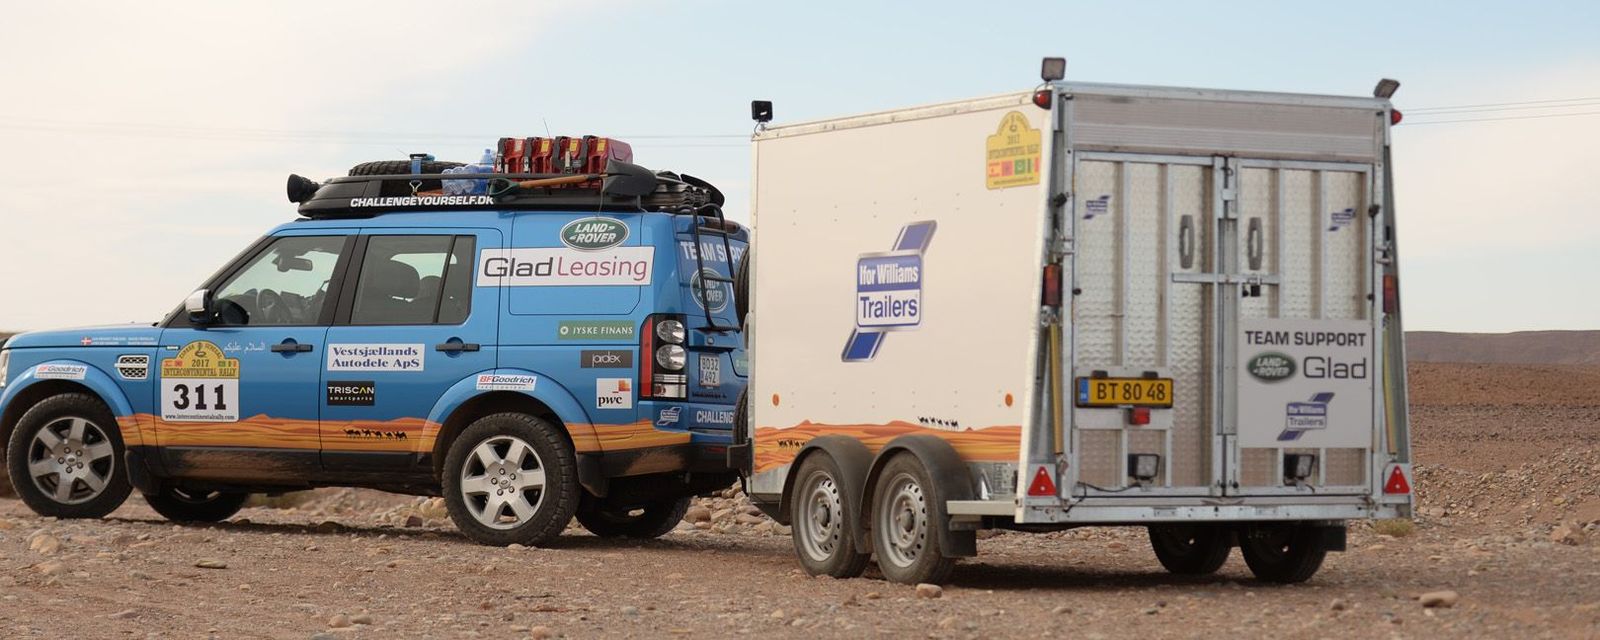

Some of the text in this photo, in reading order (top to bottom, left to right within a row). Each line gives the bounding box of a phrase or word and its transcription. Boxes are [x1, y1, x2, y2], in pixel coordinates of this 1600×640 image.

[350, 195, 494, 207] CHALLENGEYOURSELF.DK
[574, 223, 608, 233] LAND
[576, 233, 617, 243] ROVER
[484, 256, 648, 281] Glad Leasing
[860, 263, 919, 285] Ifor Williams
[702, 290, 723, 302] OVER
[860, 295, 918, 318] Trailers
[573, 326, 633, 335] JYSKE FINANS
[1245, 331, 1367, 346] TEAM SUPPORT
[192, 359, 209, 367] 2017
[332, 359, 420, 369] Autodele ApS
[1257, 358, 1283, 367] LAND
[1303, 356, 1367, 379] Glad
[1259, 367, 1291, 377] ROVER
[479, 375, 534, 384] BFGoodrich
[328, 386, 375, 394] TRISCAN
[1097, 383, 1166, 401] BT 80 48
[173, 384, 227, 410] 311
[598, 395, 623, 407] pwc
